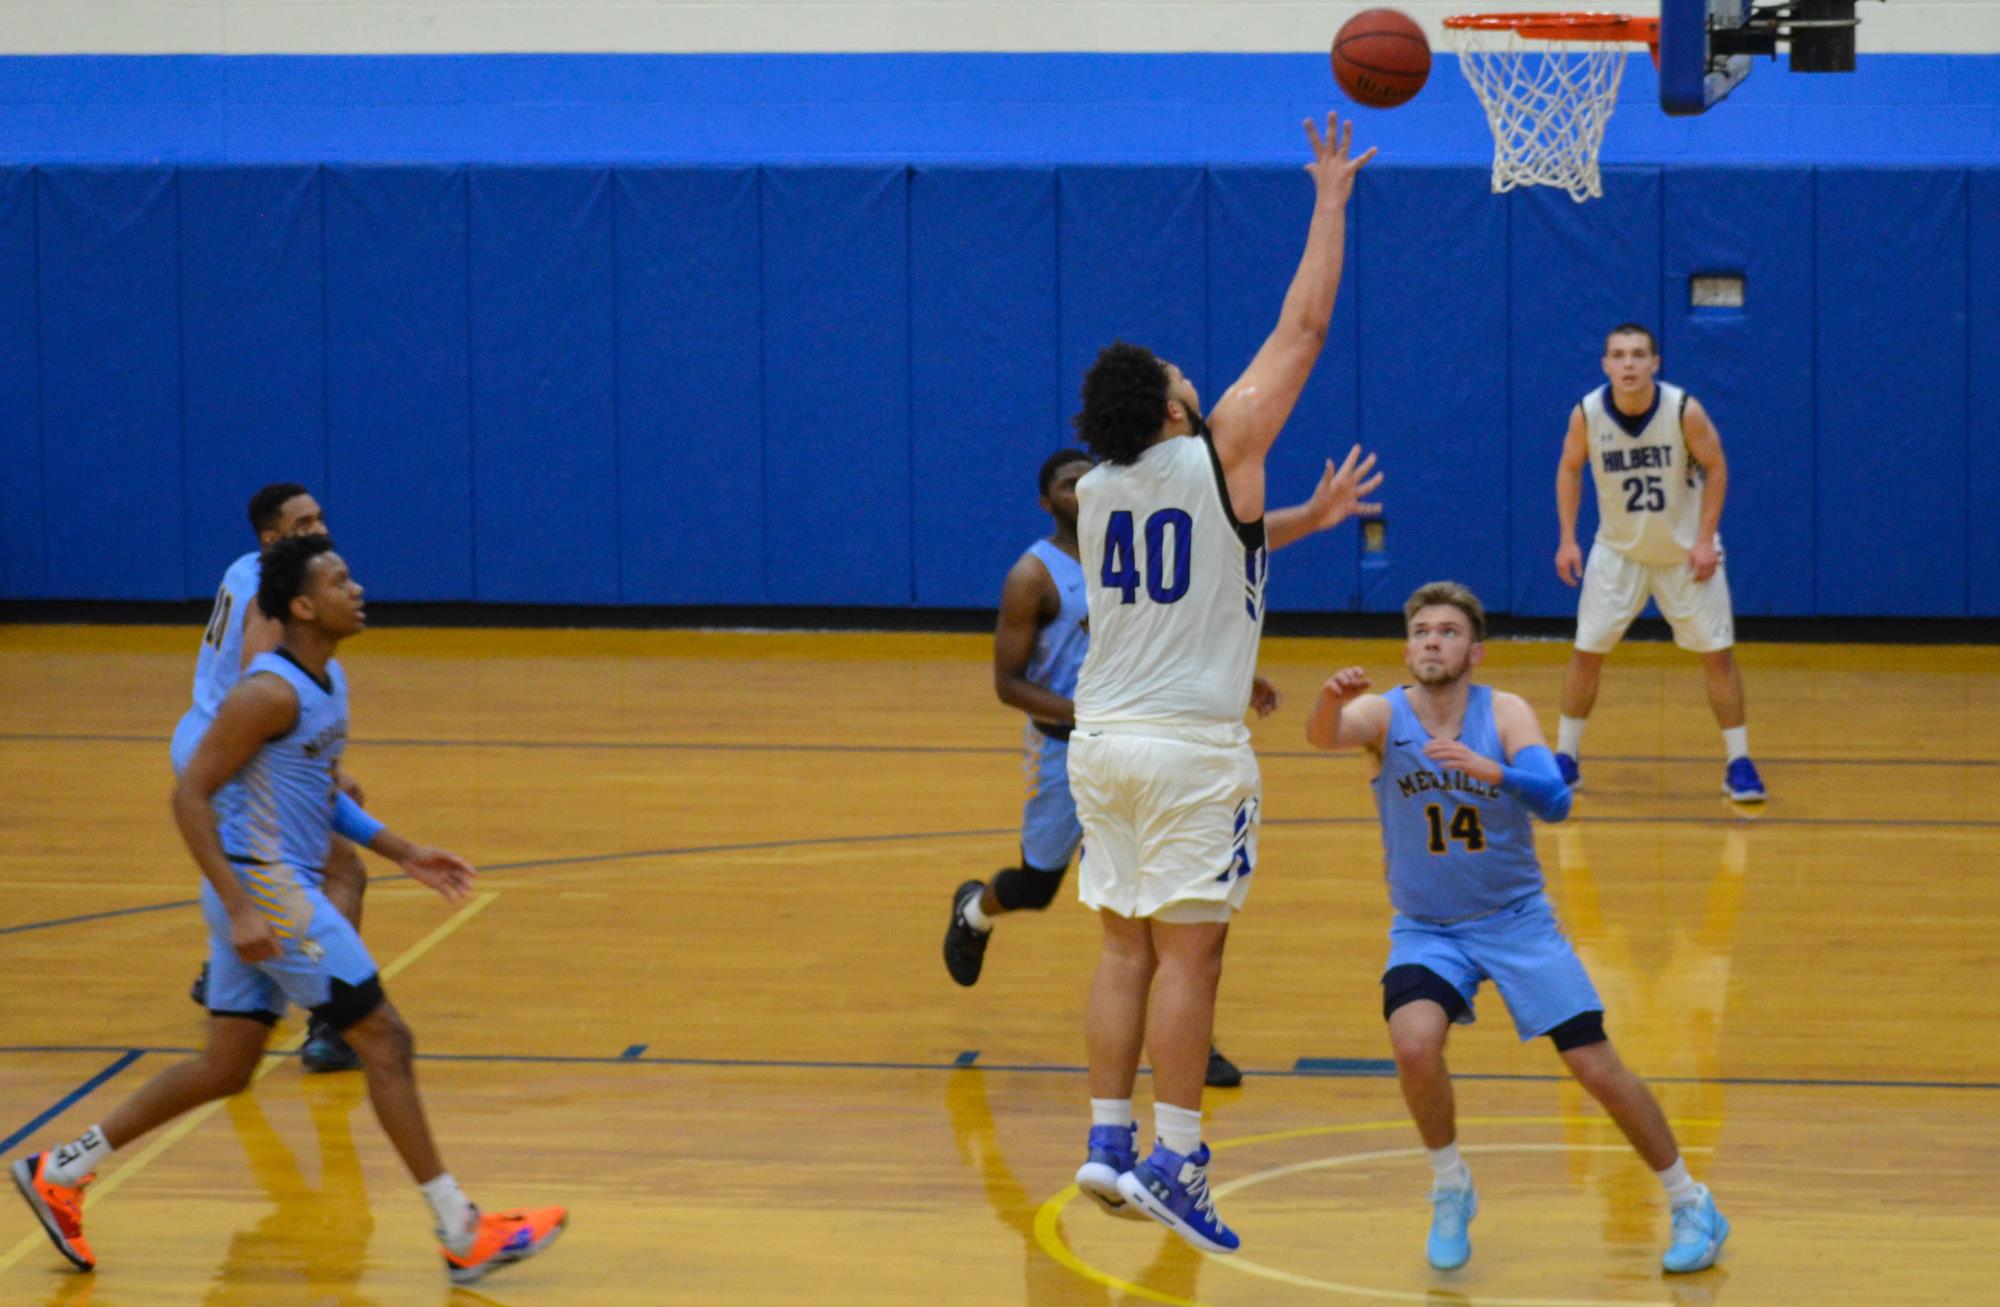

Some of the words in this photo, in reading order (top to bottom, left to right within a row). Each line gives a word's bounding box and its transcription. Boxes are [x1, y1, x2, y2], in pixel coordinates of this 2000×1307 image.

[1602, 446, 1671, 473] HILBERT
[1622, 476, 1665, 513] 25
[1101, 508, 1193, 605] 40
[1396, 769, 1499, 798] MEILLE
[1425, 803, 1486, 854] 14
